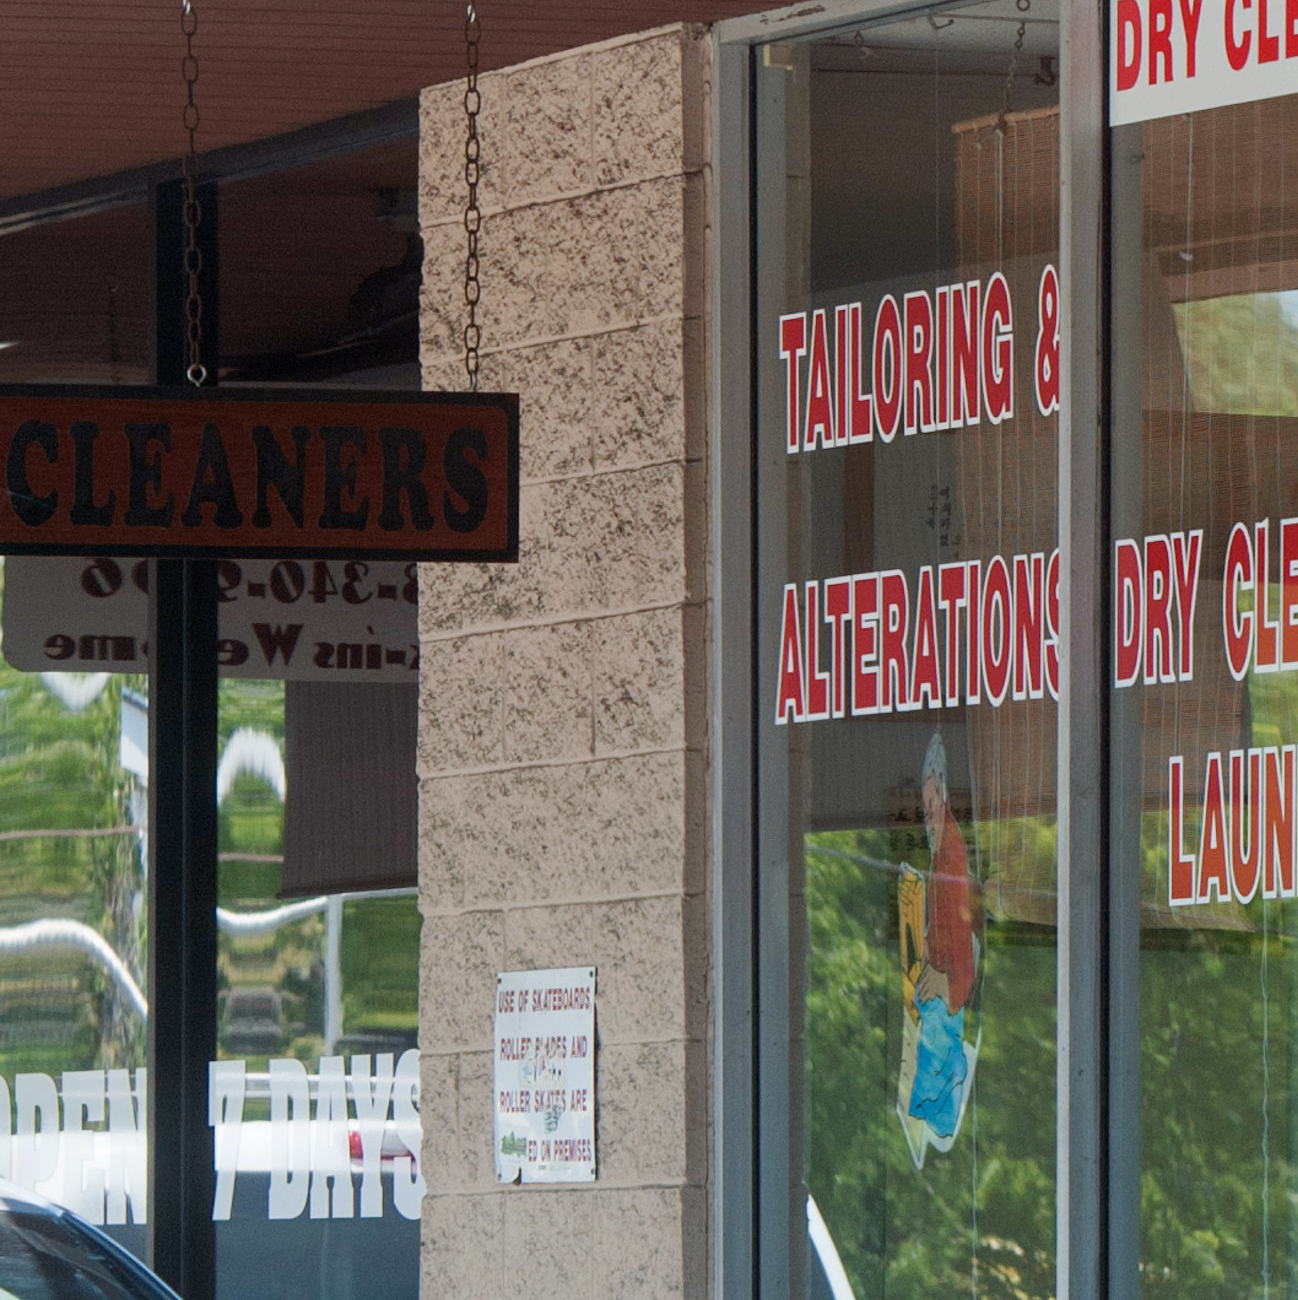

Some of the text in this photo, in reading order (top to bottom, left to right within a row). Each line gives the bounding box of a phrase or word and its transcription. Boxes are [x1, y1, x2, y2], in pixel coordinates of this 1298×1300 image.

[779, 263, 1060, 454] TAILORING &
[6, 418, 489, 533] CLEANERS
[1115, 529, 1203, 688] DRY
[499, 990, 515, 1013] USE
[519, 989, 529, 1013] OF
[571, 1035, 588, 1058] AND
[208, 1060, 246, 1221] 7
[268, 1049, 427, 1221] DAYS
[570, 1088, 587, 1112] ARE
